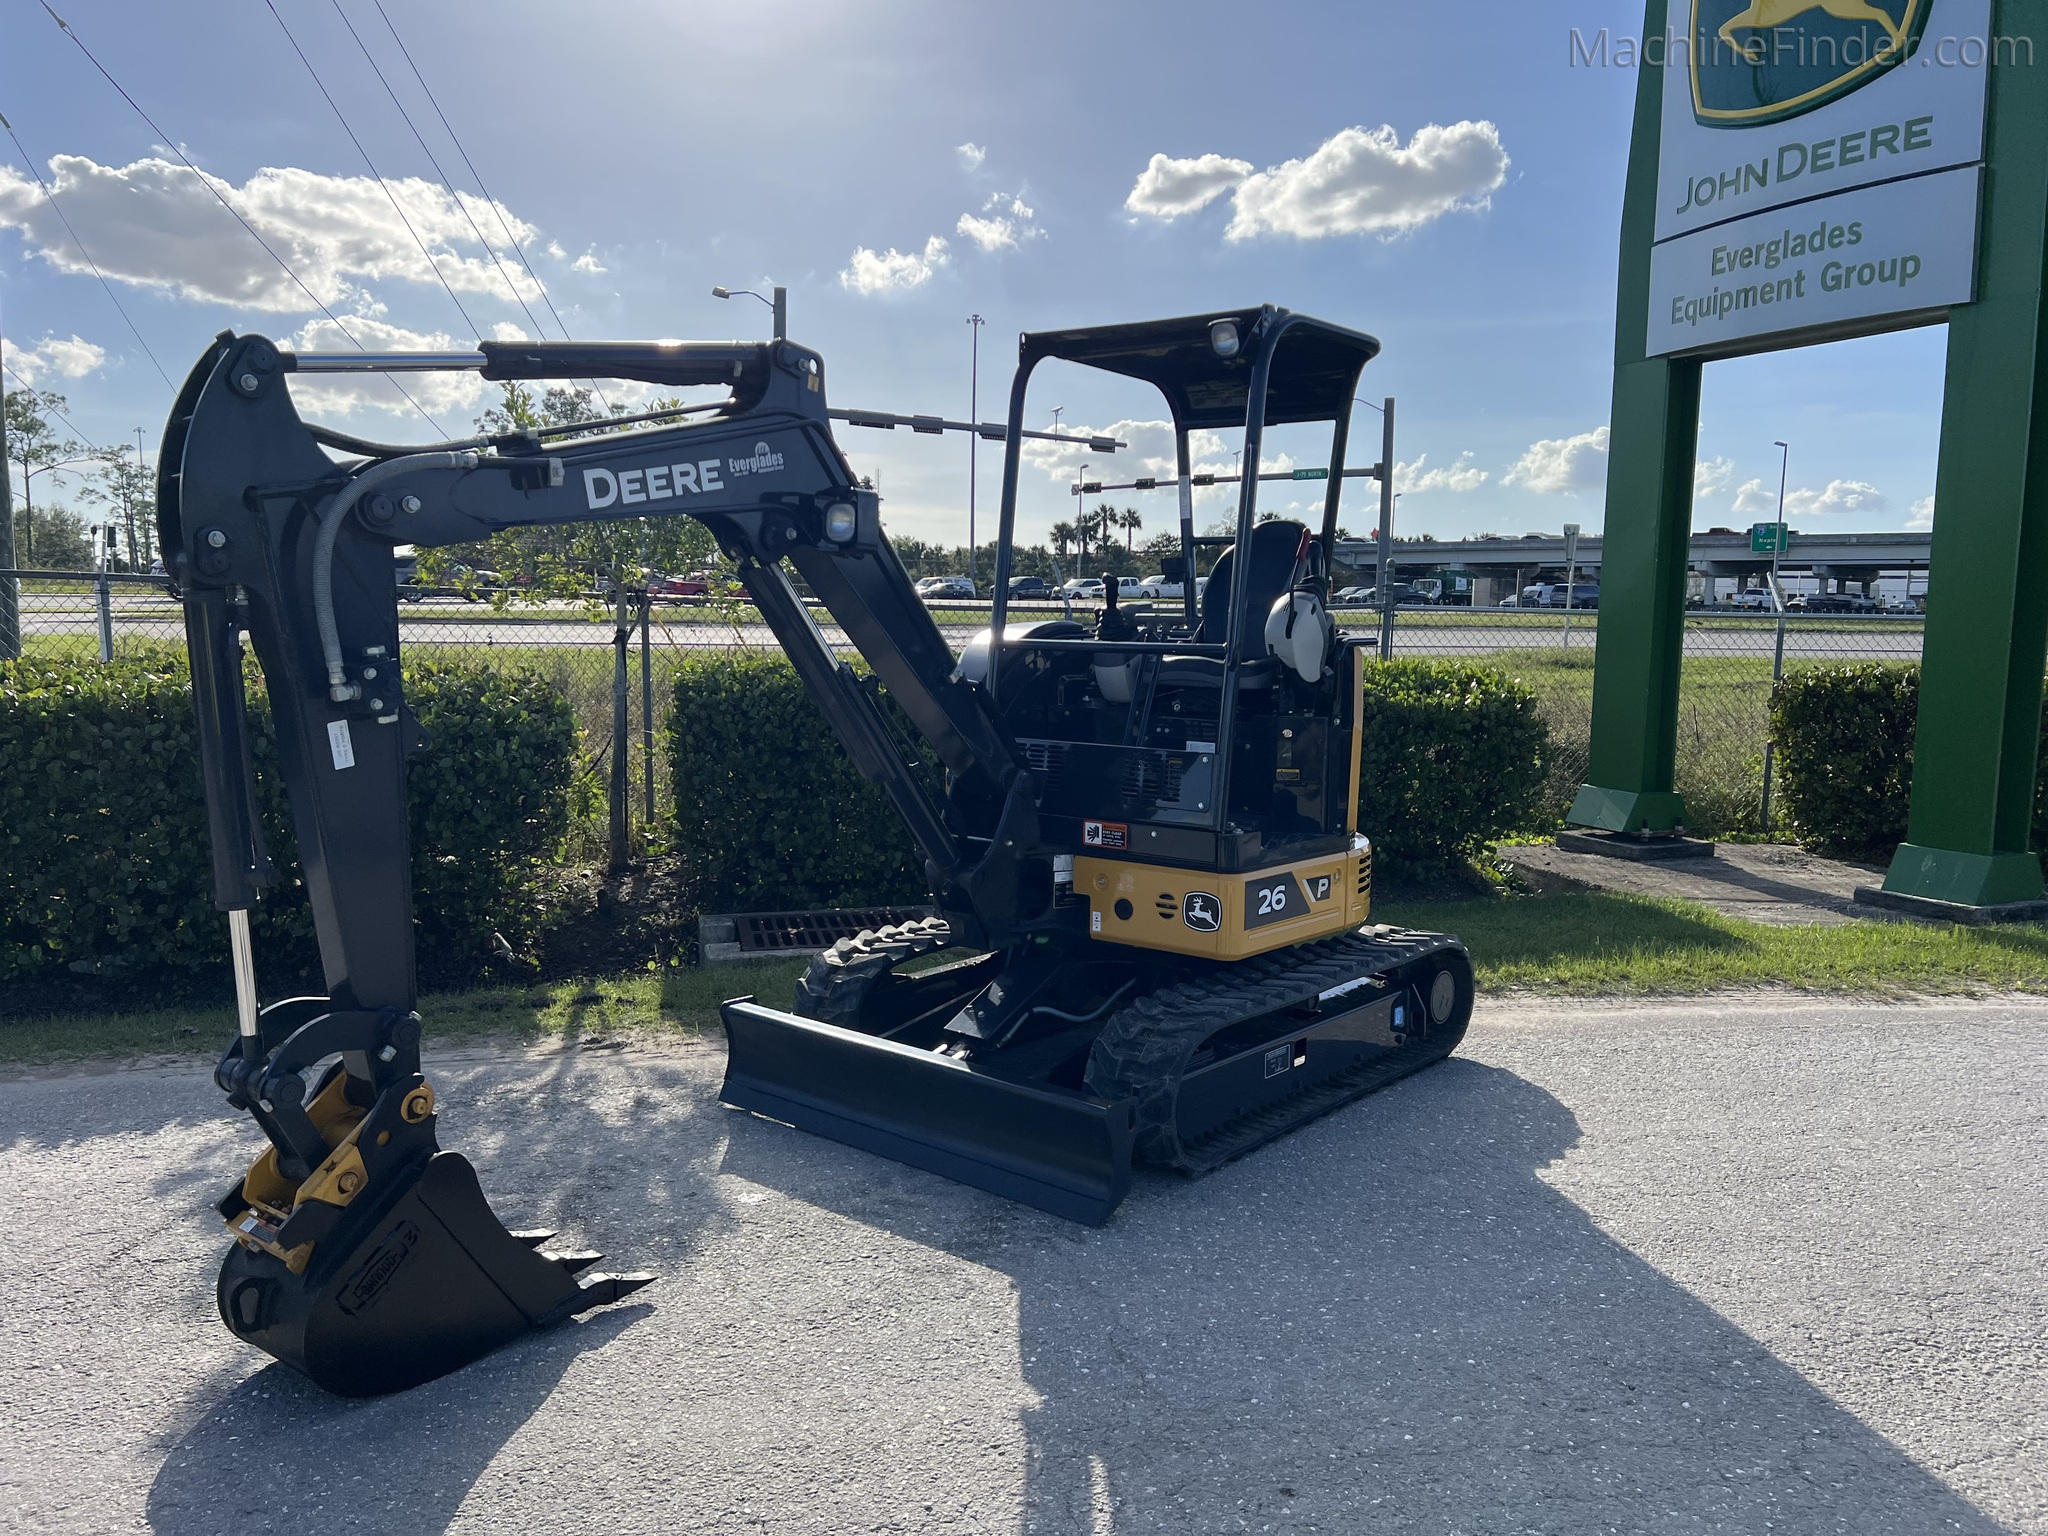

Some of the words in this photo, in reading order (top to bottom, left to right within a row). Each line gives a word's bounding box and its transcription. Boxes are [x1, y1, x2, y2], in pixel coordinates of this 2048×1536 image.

[1676, 157, 1768, 214] JOHN
[1776, 115, 1934, 182] DEERE
[1711, 219, 1863, 277] Everglades
[1671, 270, 1806, 327] Equipment
[1820, 253, 1921, 292] Group
[583, 459, 725, 510] DEERE
[728, 452, 784, 473] Everglades
[1258, 885, 1286, 915] 26
[1317, 878, 1329, 899] P
